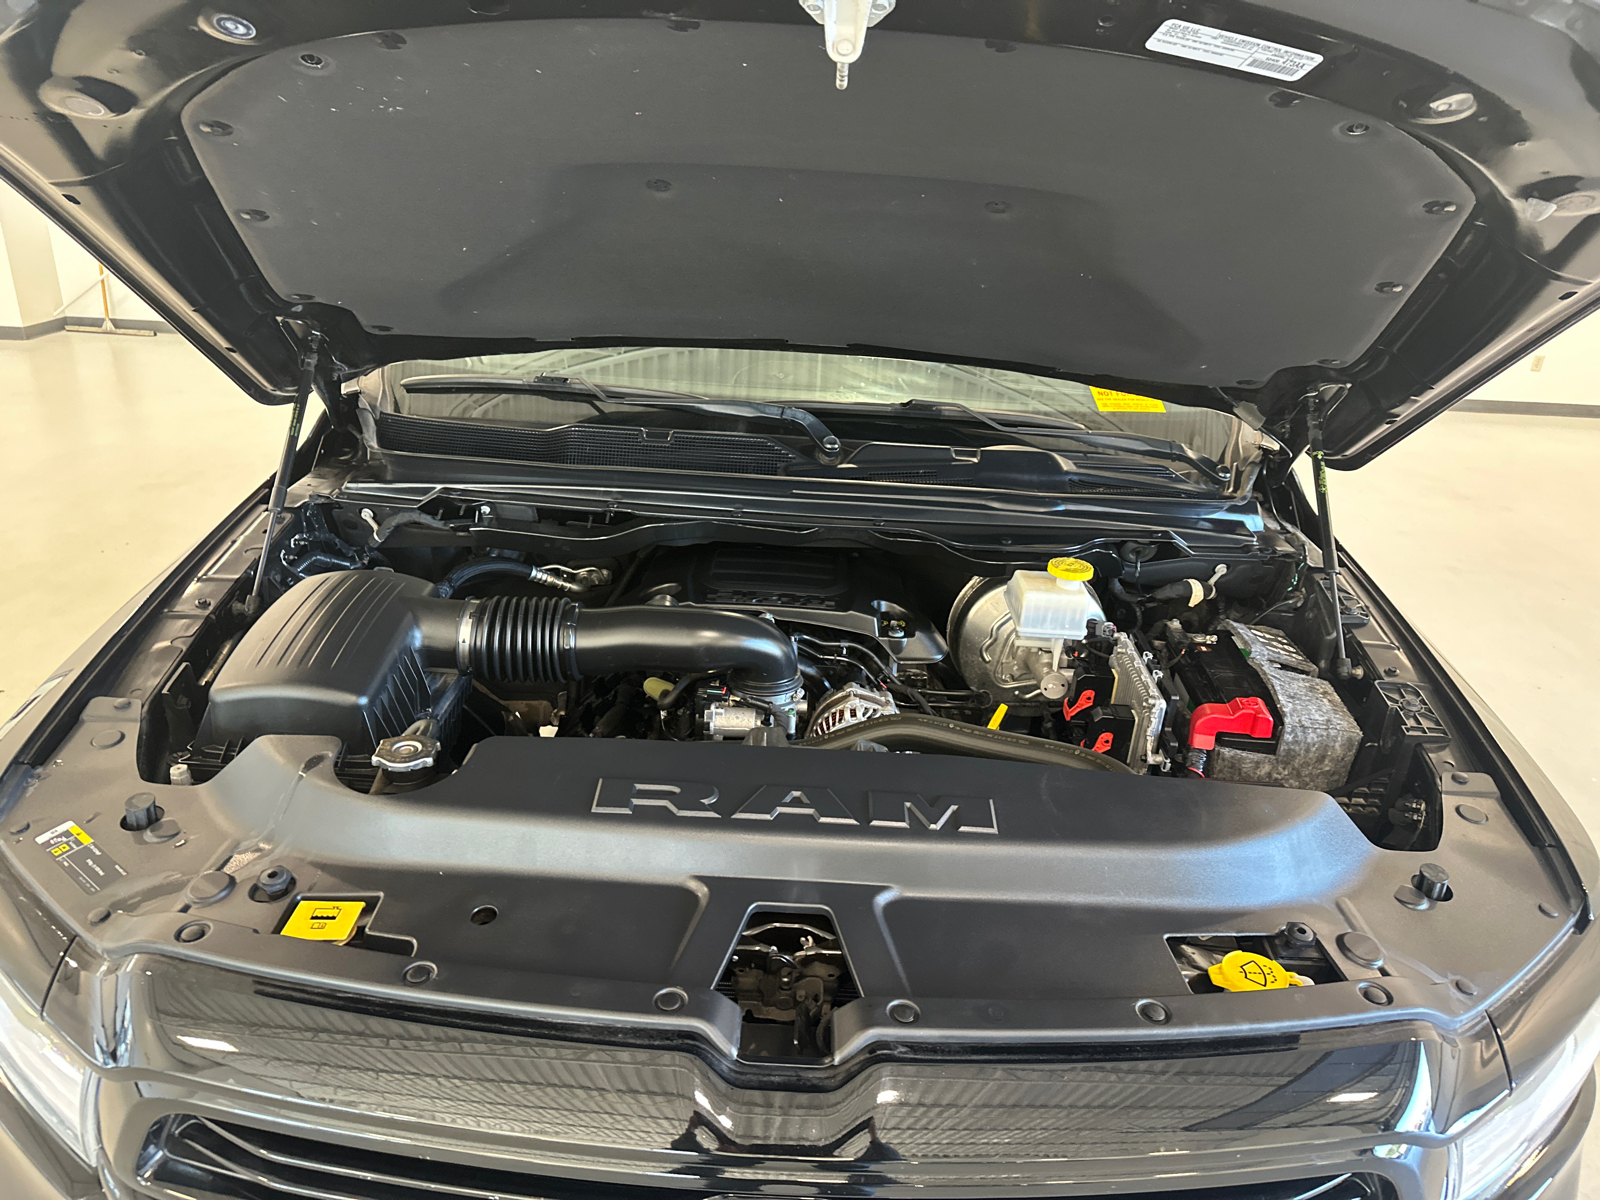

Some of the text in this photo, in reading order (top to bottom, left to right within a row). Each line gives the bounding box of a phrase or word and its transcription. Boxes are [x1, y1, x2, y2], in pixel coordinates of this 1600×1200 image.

[1218, 34, 1239, 42] VEHICLE
[1238, 38, 1261, 47] EMISSION
[1261, 44, 1282, 53] CONTROL
[1283, 49, 1316, 60] INFORMATION
[591, 778, 999, 835] RAM
